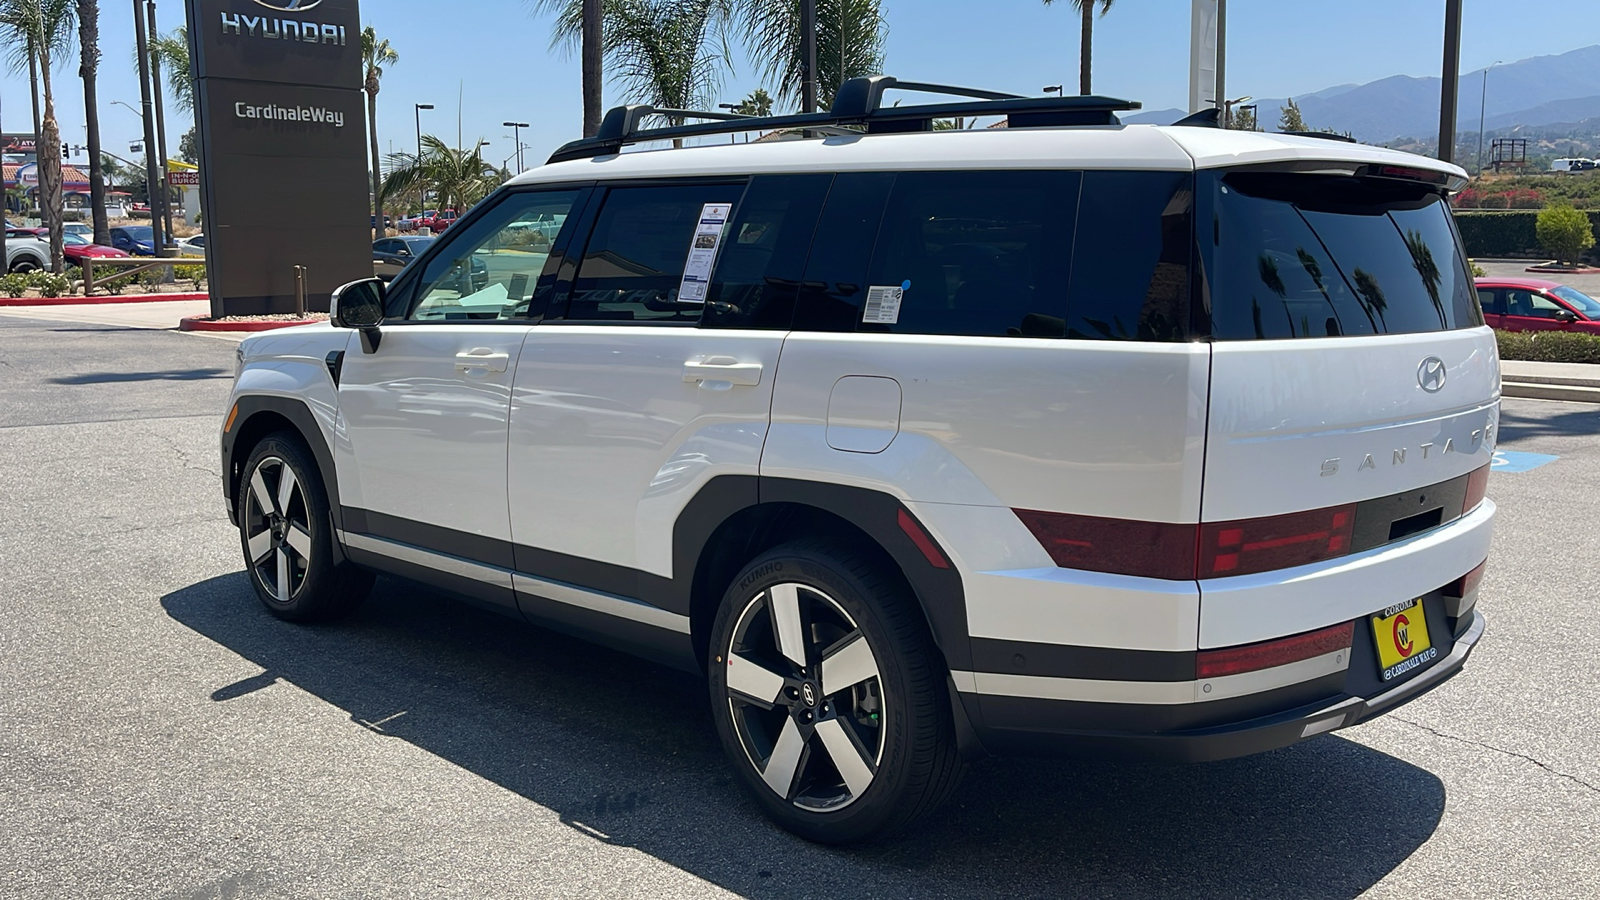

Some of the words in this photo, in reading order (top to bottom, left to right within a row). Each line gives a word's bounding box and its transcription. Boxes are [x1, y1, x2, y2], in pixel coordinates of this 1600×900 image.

[220, 11, 346, 46] HYUNDAI
[235, 101, 344, 127] CardinaleWay
[1320, 438, 1454, 477] SANTA
[1471, 423, 1493, 445] FE
[740, 561, 783, 590] KUMHO
[1384, 599, 1414, 617] CORONA
[1391, 656, 1420, 677] CARDINALE
[1419, 650, 1431, 664] WAY
